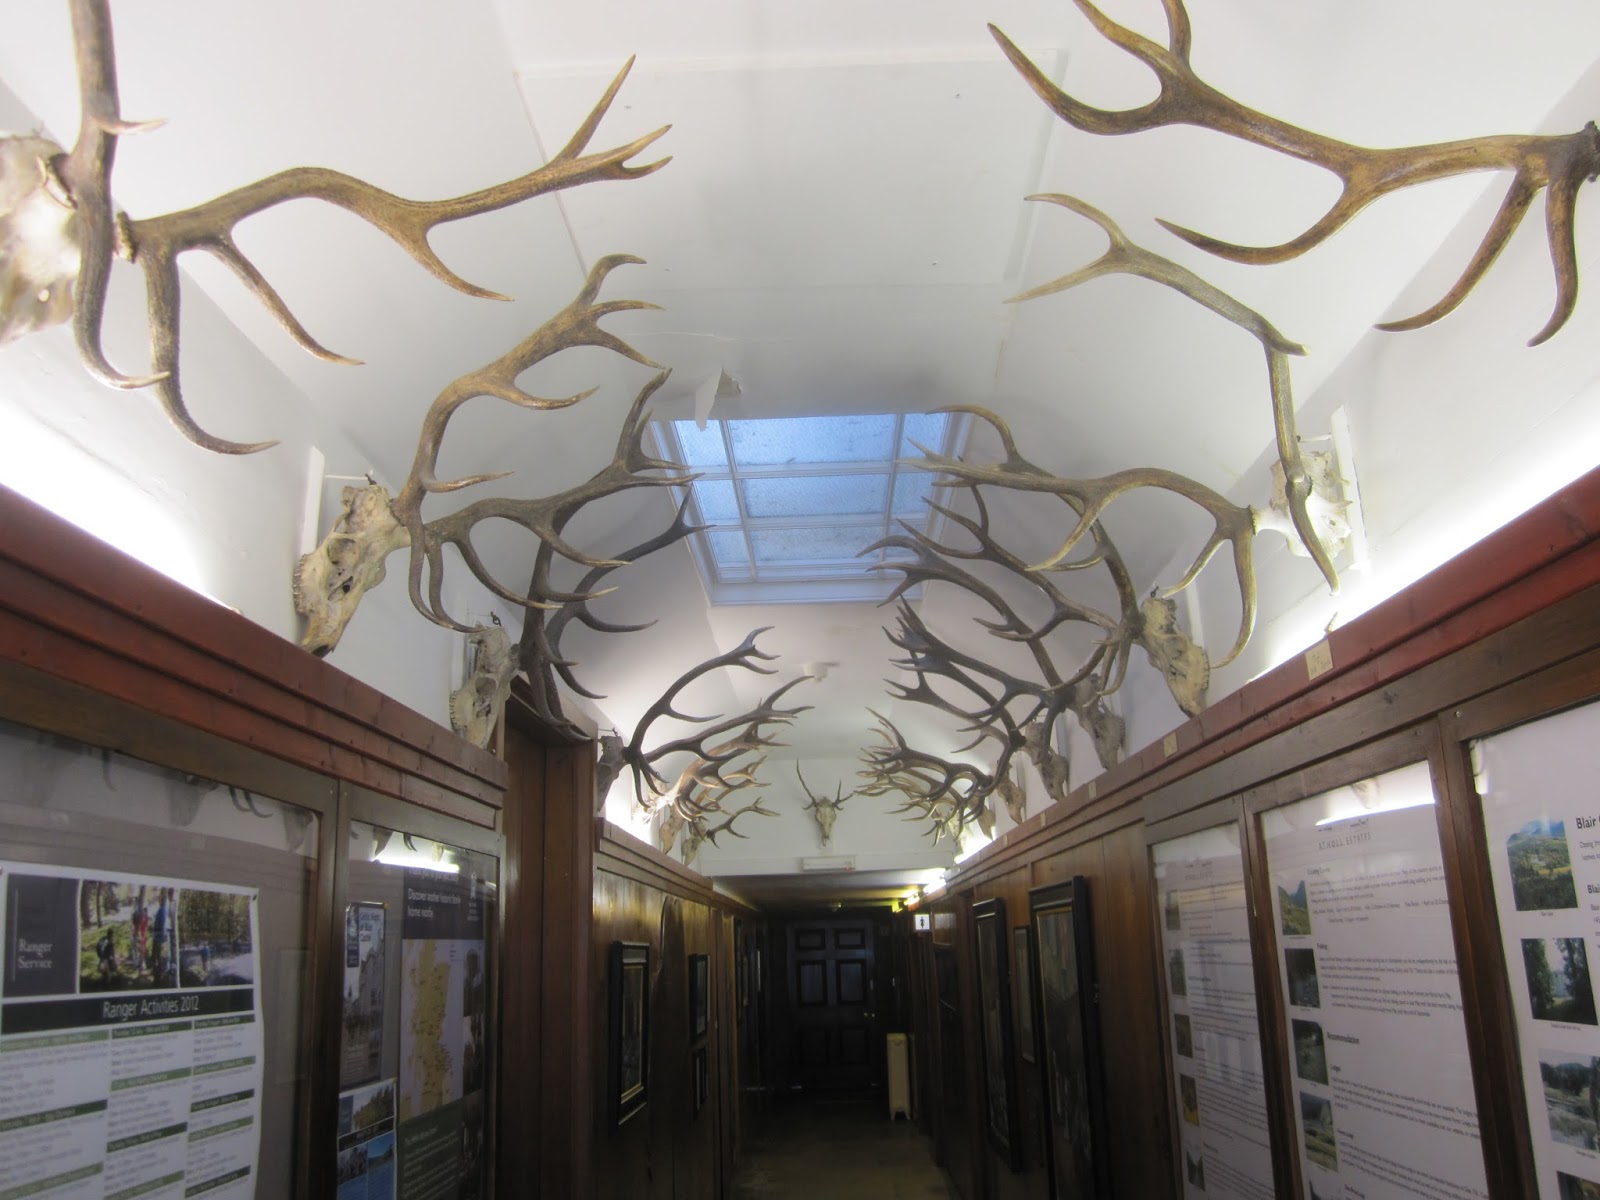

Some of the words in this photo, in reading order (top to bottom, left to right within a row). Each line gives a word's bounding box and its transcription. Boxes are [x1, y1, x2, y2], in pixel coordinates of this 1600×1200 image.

[1575, 816, 1597, 830] Blair
[18, 938, 53, 958] Ranger
[17, 955, 53, 969] Service
[103, 1001, 138, 1021] Ranger
[141, 999, 179, 1015] Activities
[181, 995, 200, 1012] 2012
